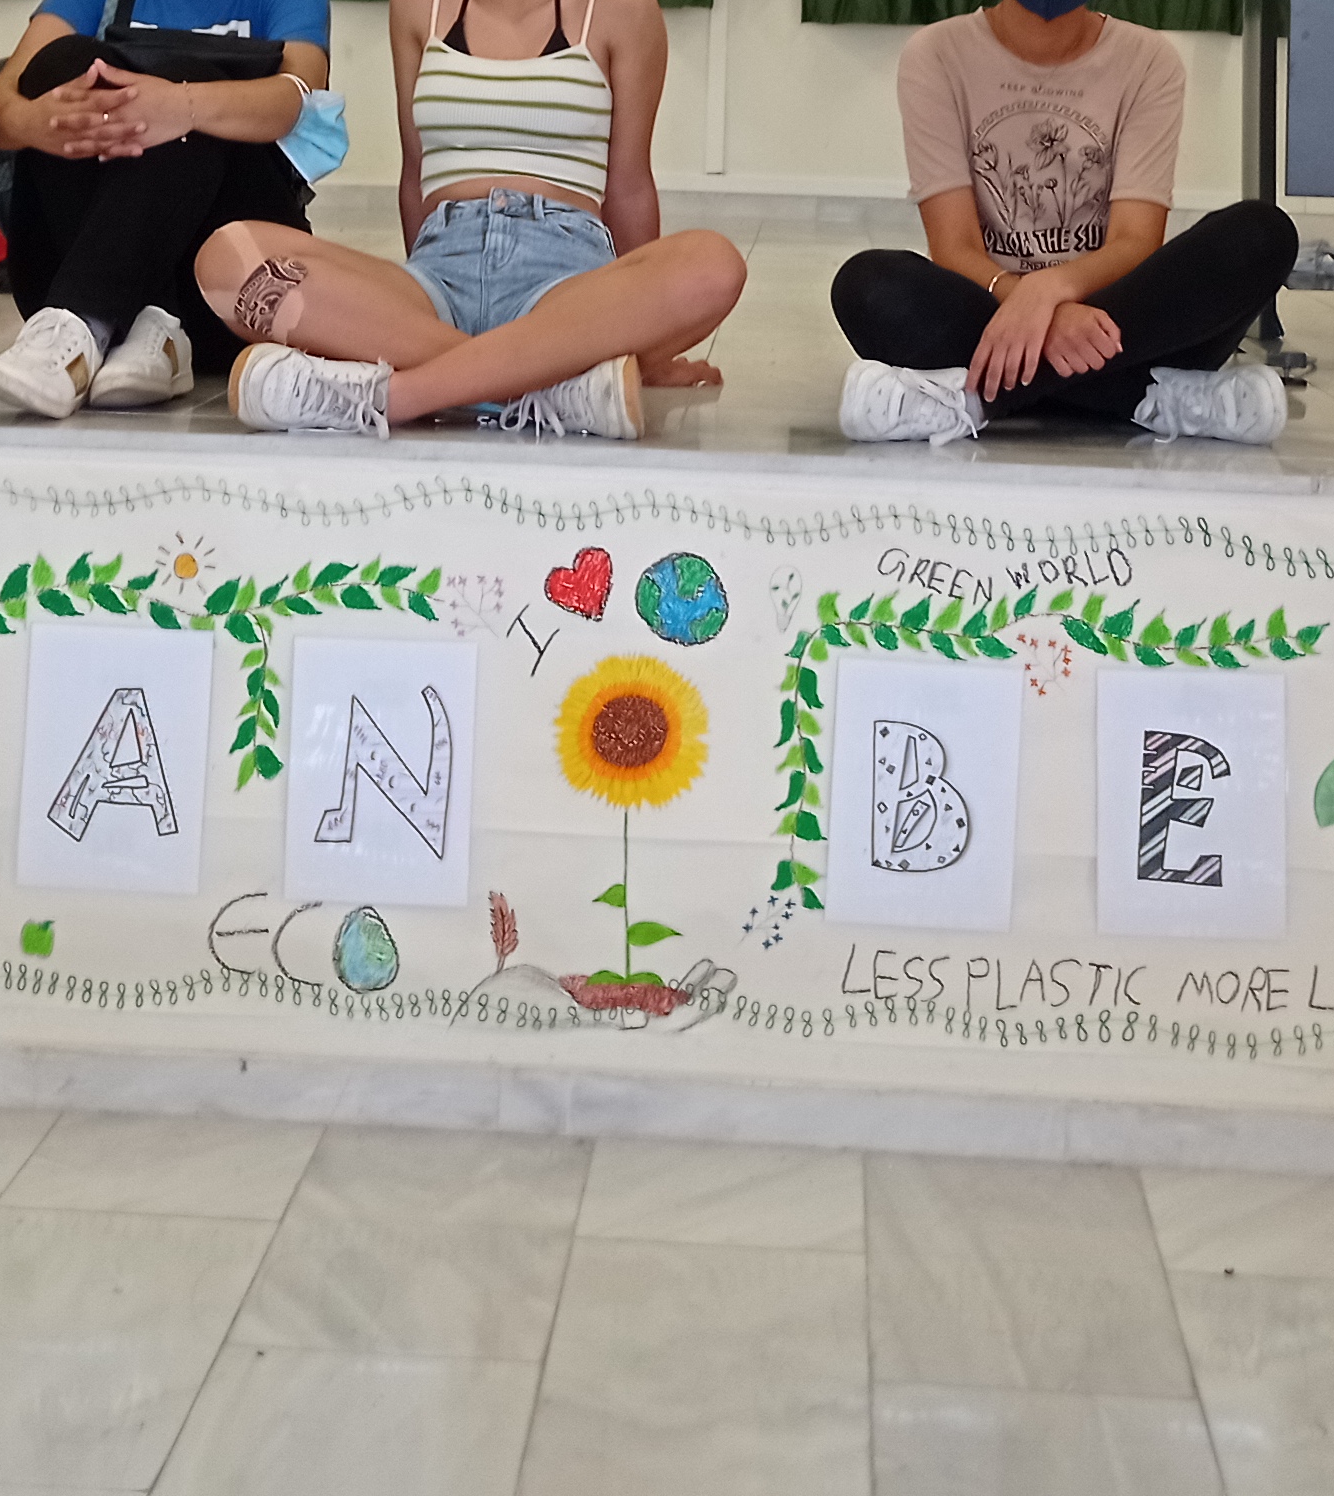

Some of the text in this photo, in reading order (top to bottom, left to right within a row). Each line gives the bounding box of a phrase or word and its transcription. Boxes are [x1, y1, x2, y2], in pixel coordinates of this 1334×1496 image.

[982, 222, 1104, 257] OLLOW THE SU
[877, 547, 1133, 606] GREEN WORLD
[841, 943, 951, 1003] LESS
[966, 956, 1148, 1012] PLASTIC
[1176, 965, 1290, 1012] MORE
